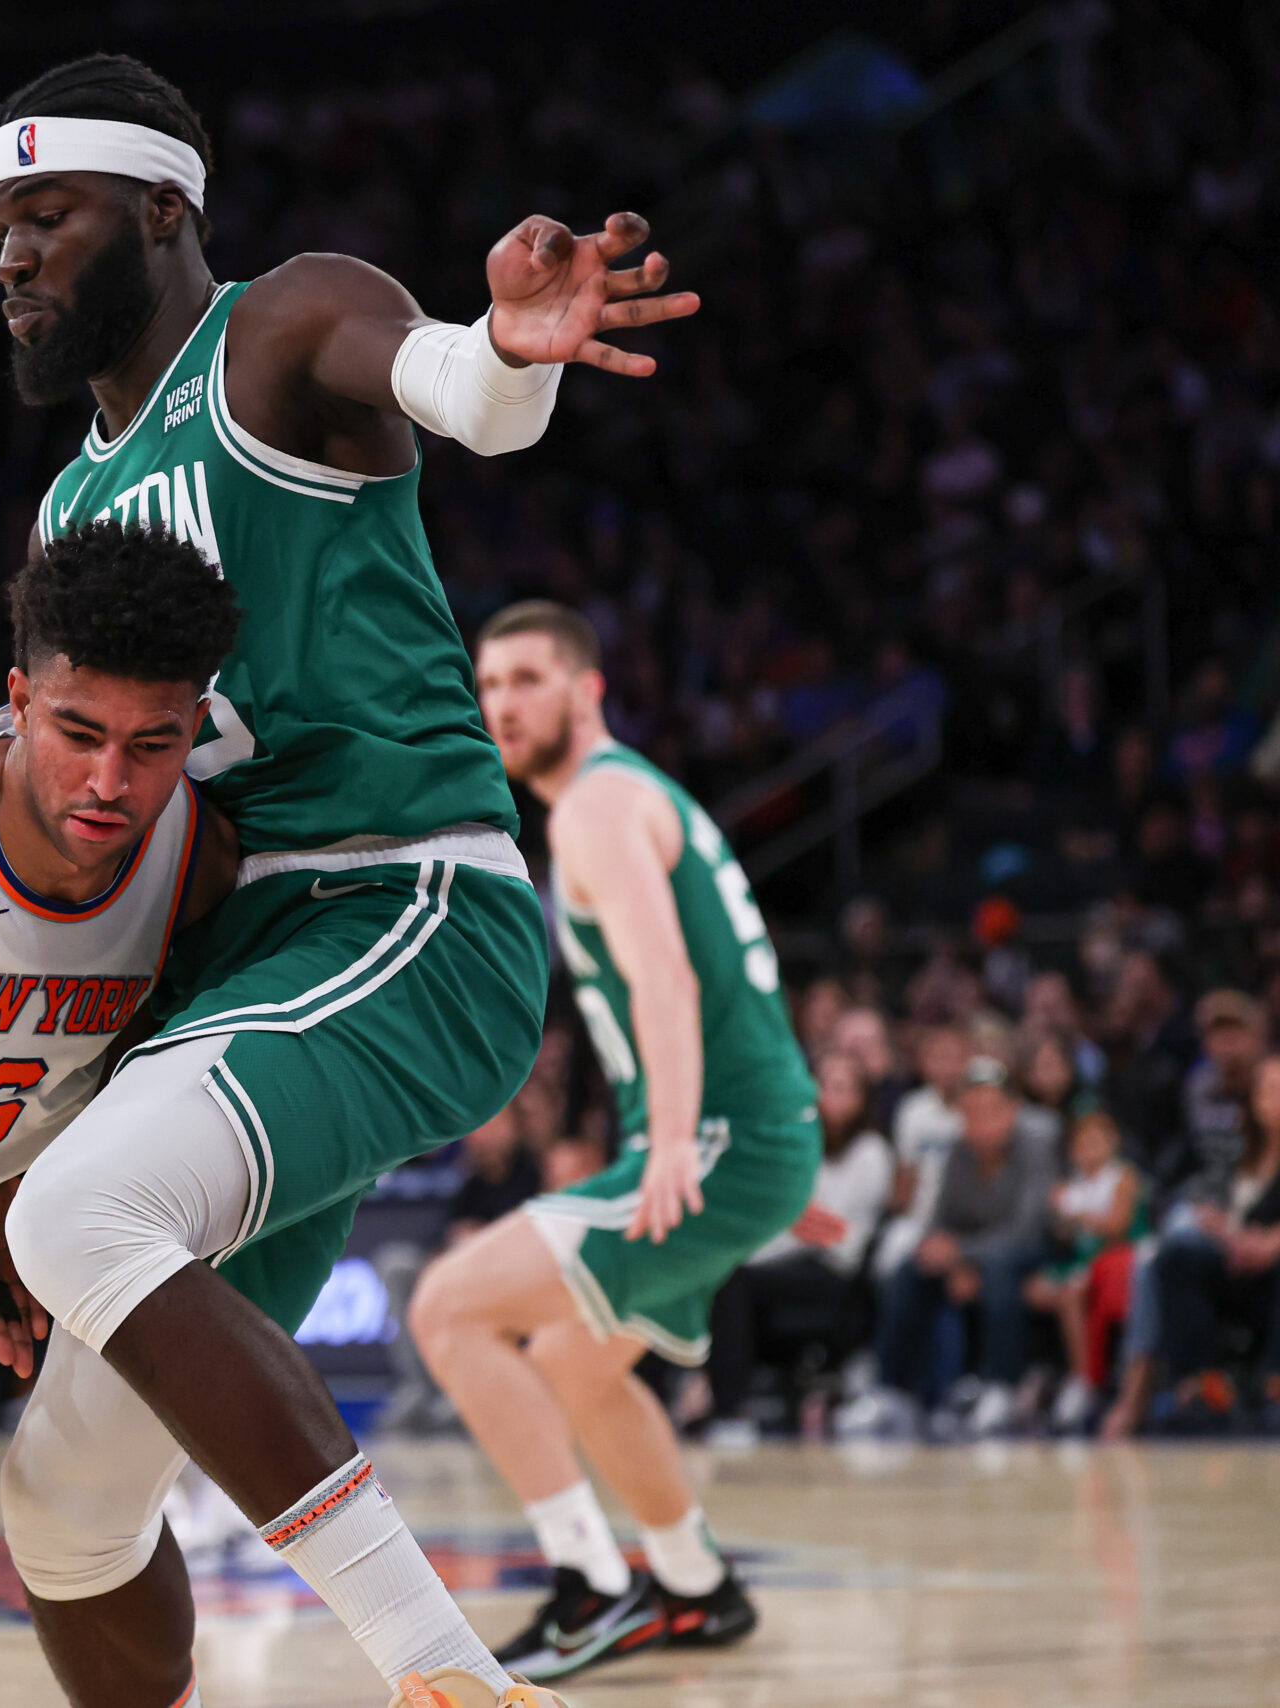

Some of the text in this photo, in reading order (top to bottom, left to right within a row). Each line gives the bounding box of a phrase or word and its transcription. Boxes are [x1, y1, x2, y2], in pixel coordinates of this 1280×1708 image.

[164, 395, 203, 433] PRINT
[166, 374, 204, 414] VISTA
[92, 460, 225, 581] TON
[32, 974, 153, 1035] YORK
